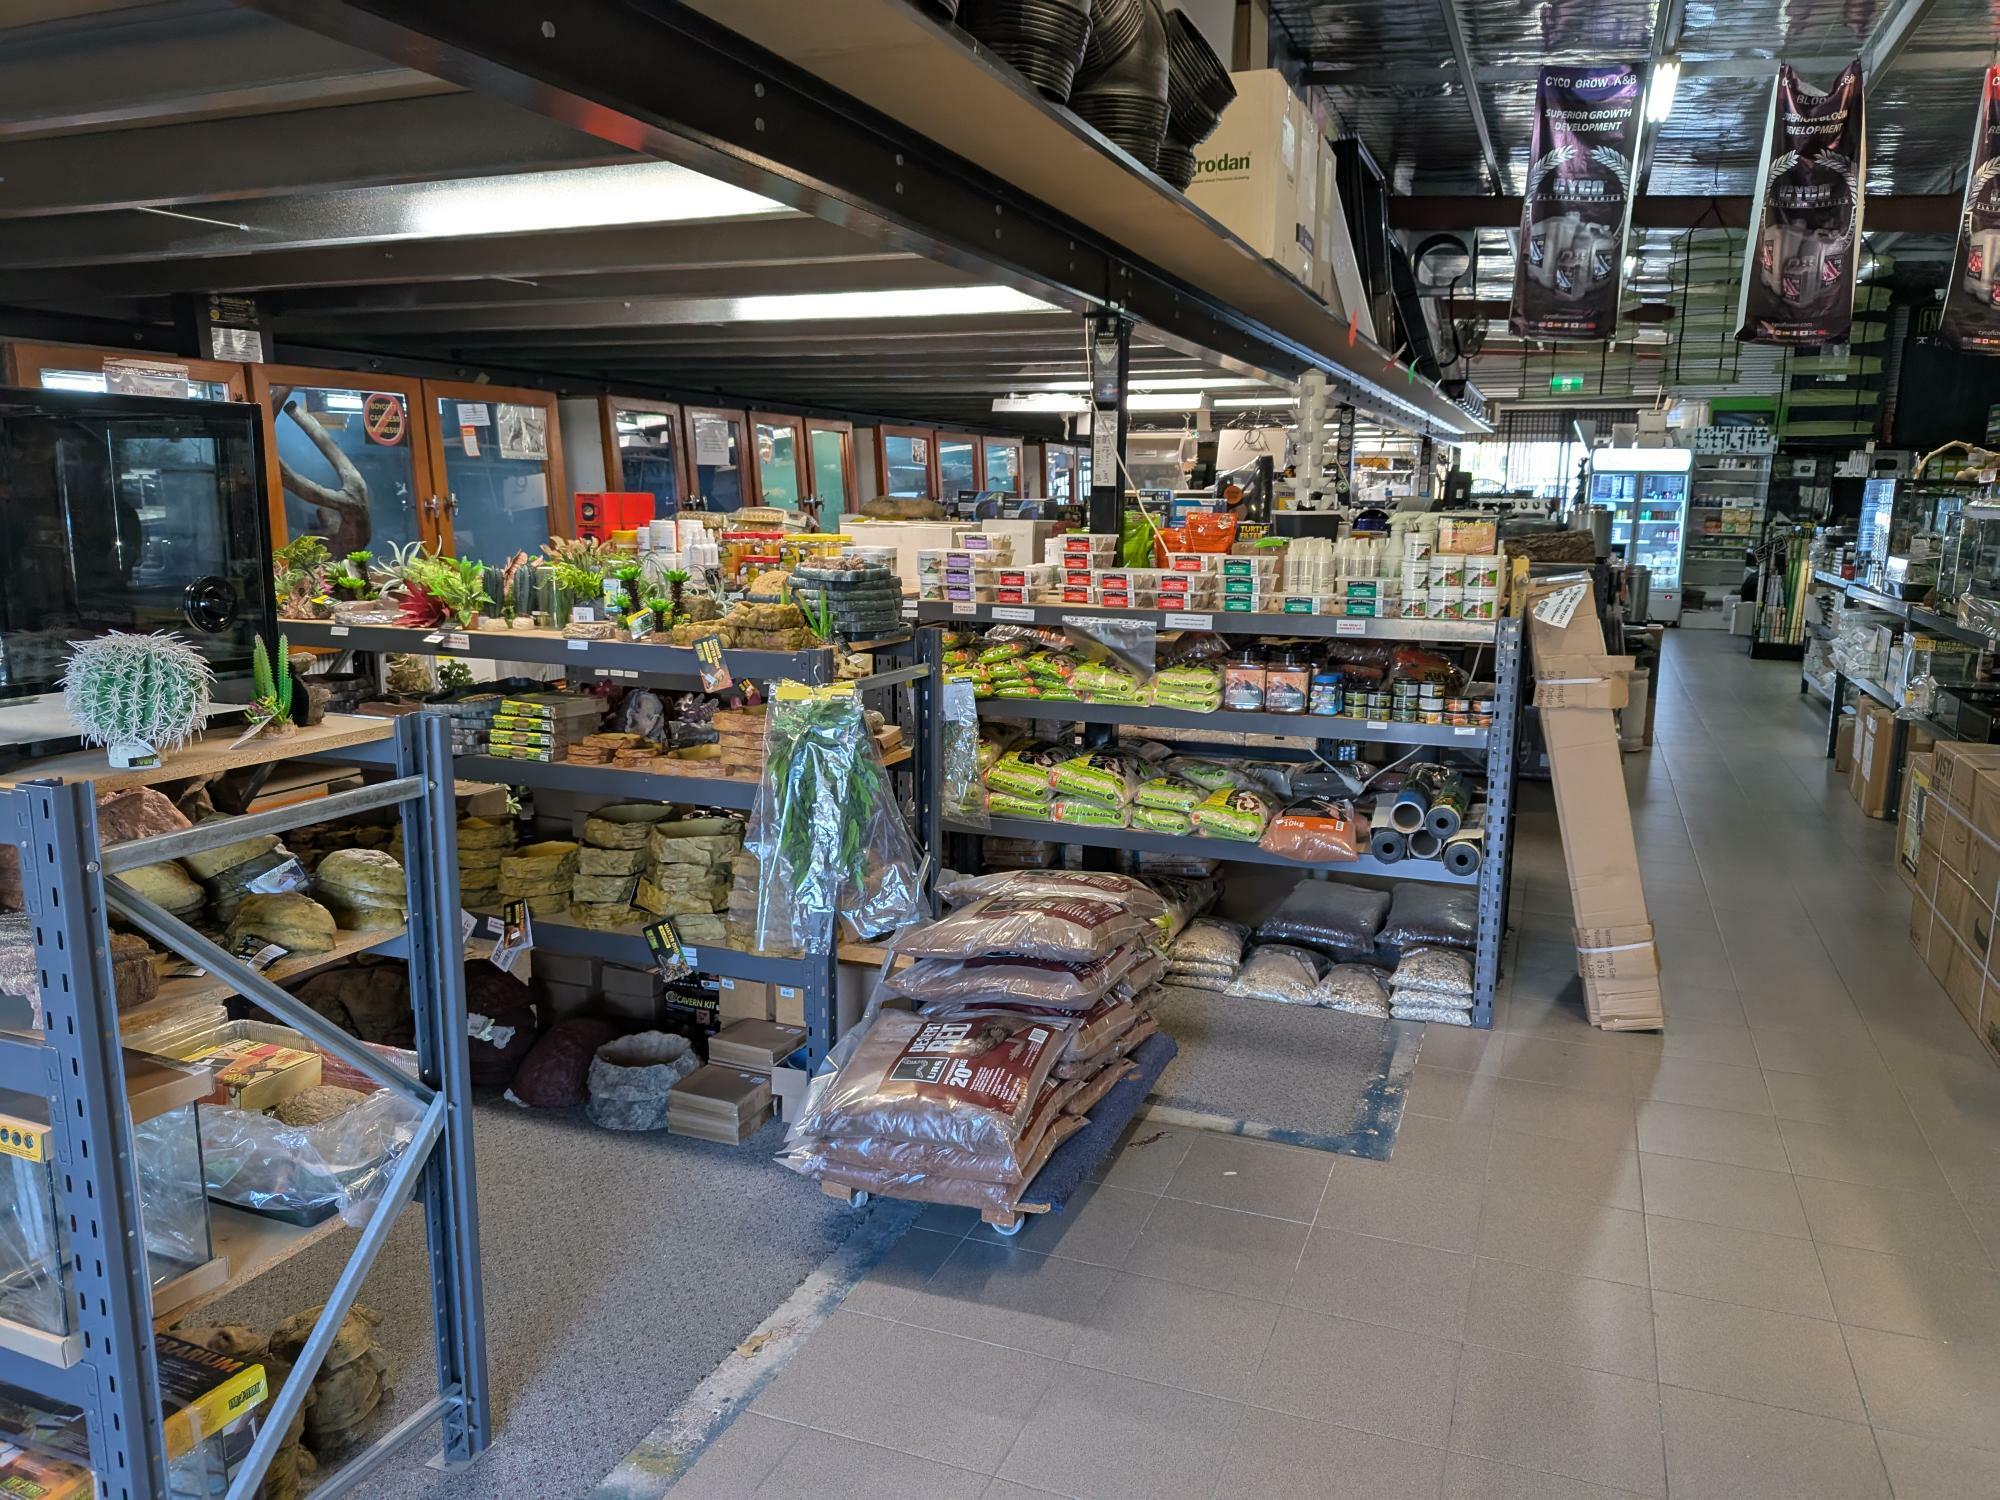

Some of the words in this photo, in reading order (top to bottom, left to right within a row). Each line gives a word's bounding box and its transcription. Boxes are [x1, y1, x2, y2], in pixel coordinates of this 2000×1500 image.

[1545, 76, 1571, 88] CYCO
[1574, 79, 1608, 89] GROW
[1613, 74, 1637, 86] A&B
[1545, 108, 1588, 120] SUPERIOR
[1589, 108, 1632, 120] GROWTH
[1554, 121, 1623, 132] DEVELOPMENT
[1240, 525, 1269, 534] TURTLE
[676, 995, 703, 1008] CAVERN
[704, 1001, 717, 1010] KIT
[924, 1022, 973, 1053] RED
[926, 1059, 943, 1080] URS
